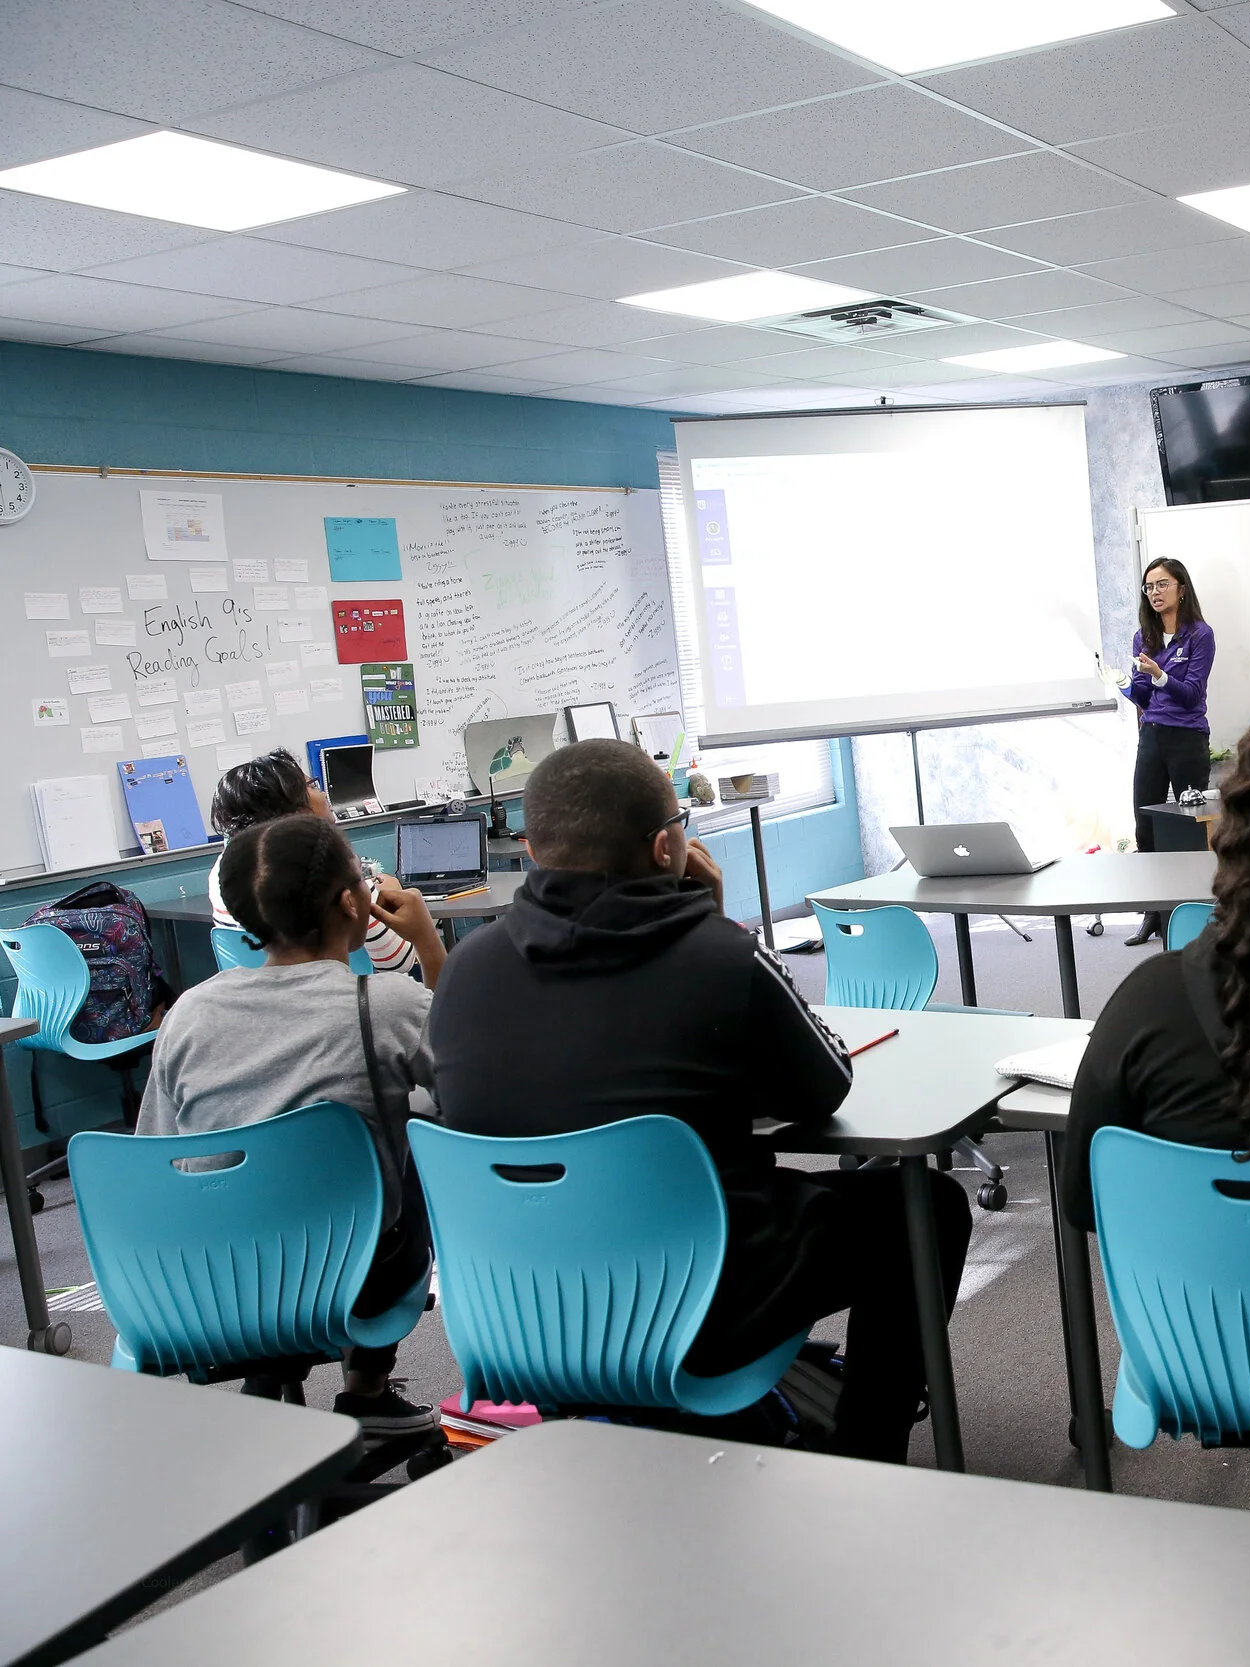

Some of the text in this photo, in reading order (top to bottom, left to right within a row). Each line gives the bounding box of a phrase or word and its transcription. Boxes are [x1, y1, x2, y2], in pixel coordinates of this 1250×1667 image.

[14, 470, 20, 479] 2
[18, 482, 25, 491] 3
[16, 494, 22, 502] 4
[9, 502, 15, 510] 5
[144, 598, 252, 647] English 9's
[126, 625, 272, 688] Reading Goals!
[374, 705, 414, 721] MASTERED.
